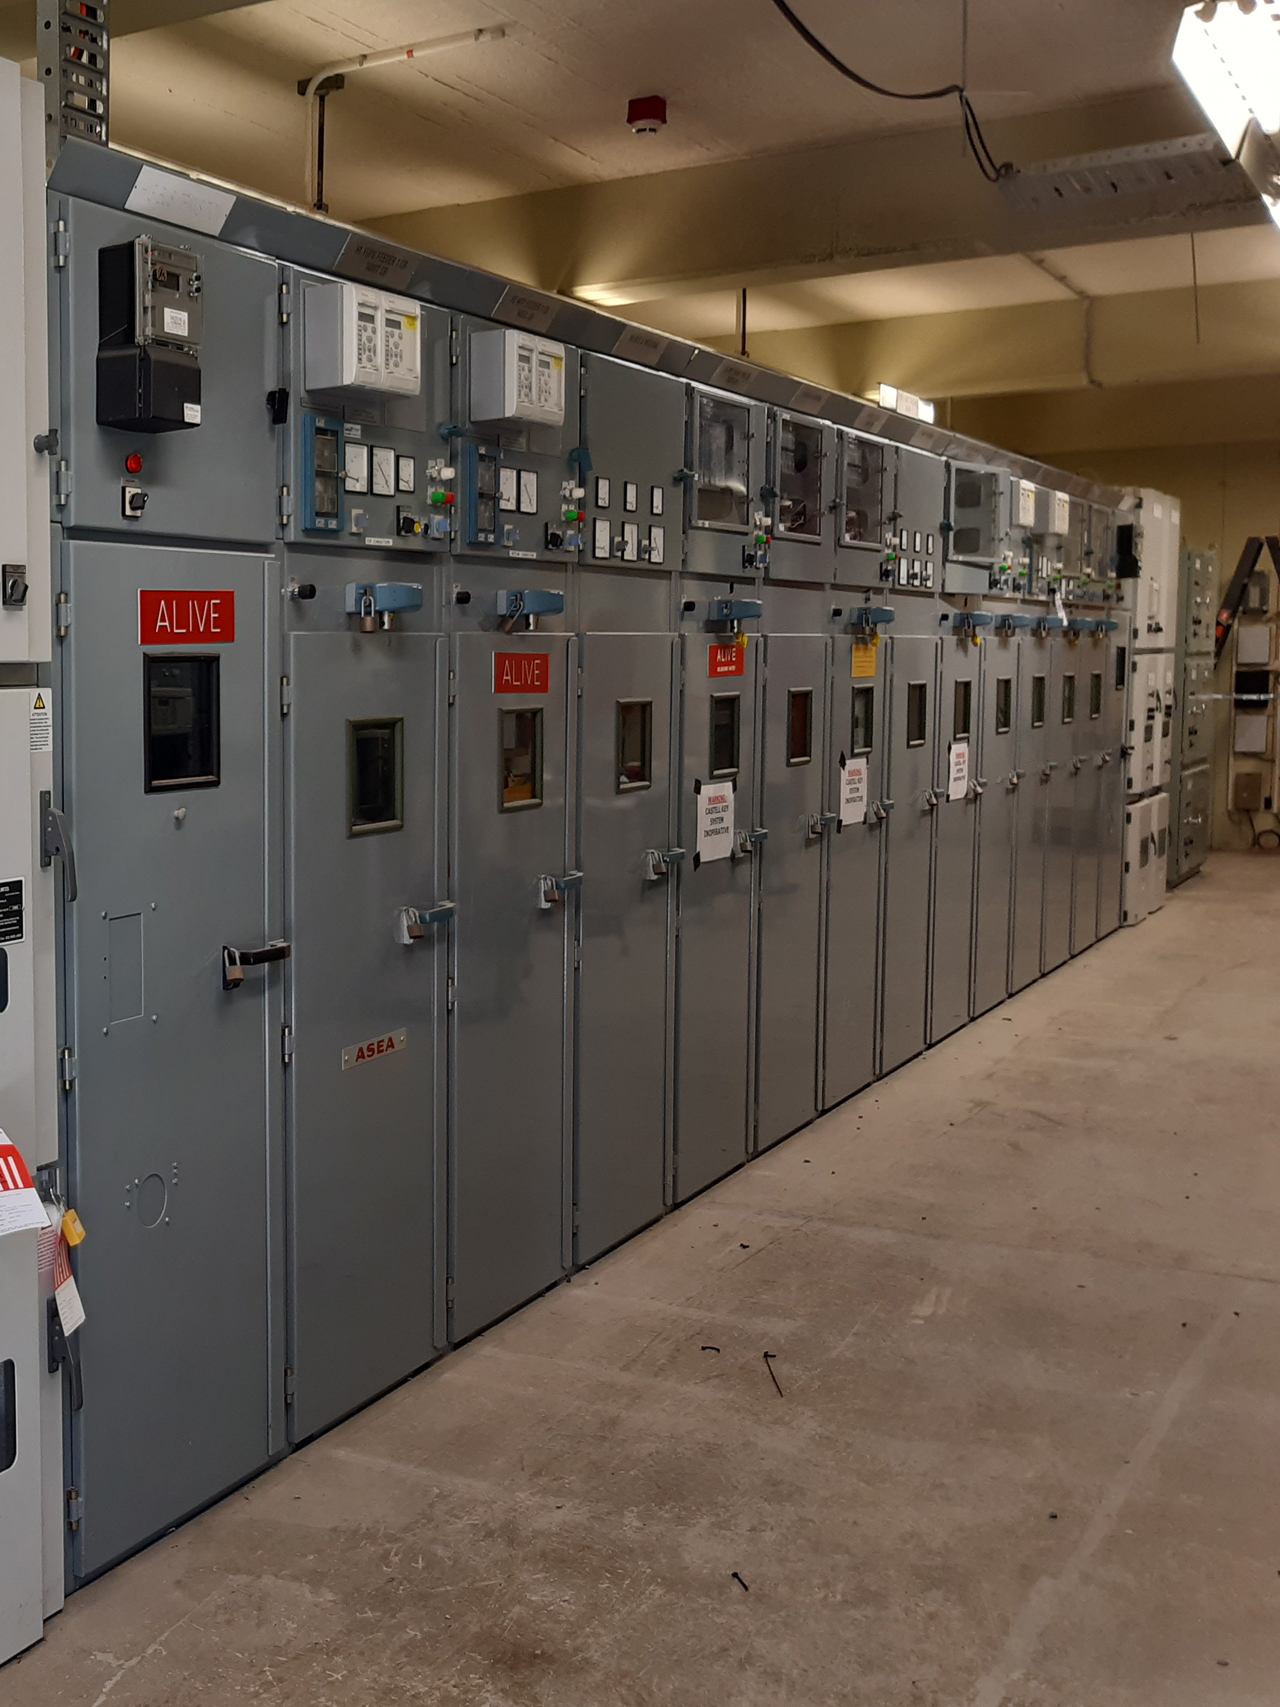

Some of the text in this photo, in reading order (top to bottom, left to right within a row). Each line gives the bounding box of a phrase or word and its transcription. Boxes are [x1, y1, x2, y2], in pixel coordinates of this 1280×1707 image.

[155, 599, 221, 633] ALIVE
[716, 647, 736, 662] ALIVE
[502, 659, 541, 685] ALIVE
[355, 1036, 395, 1063] ASEA
